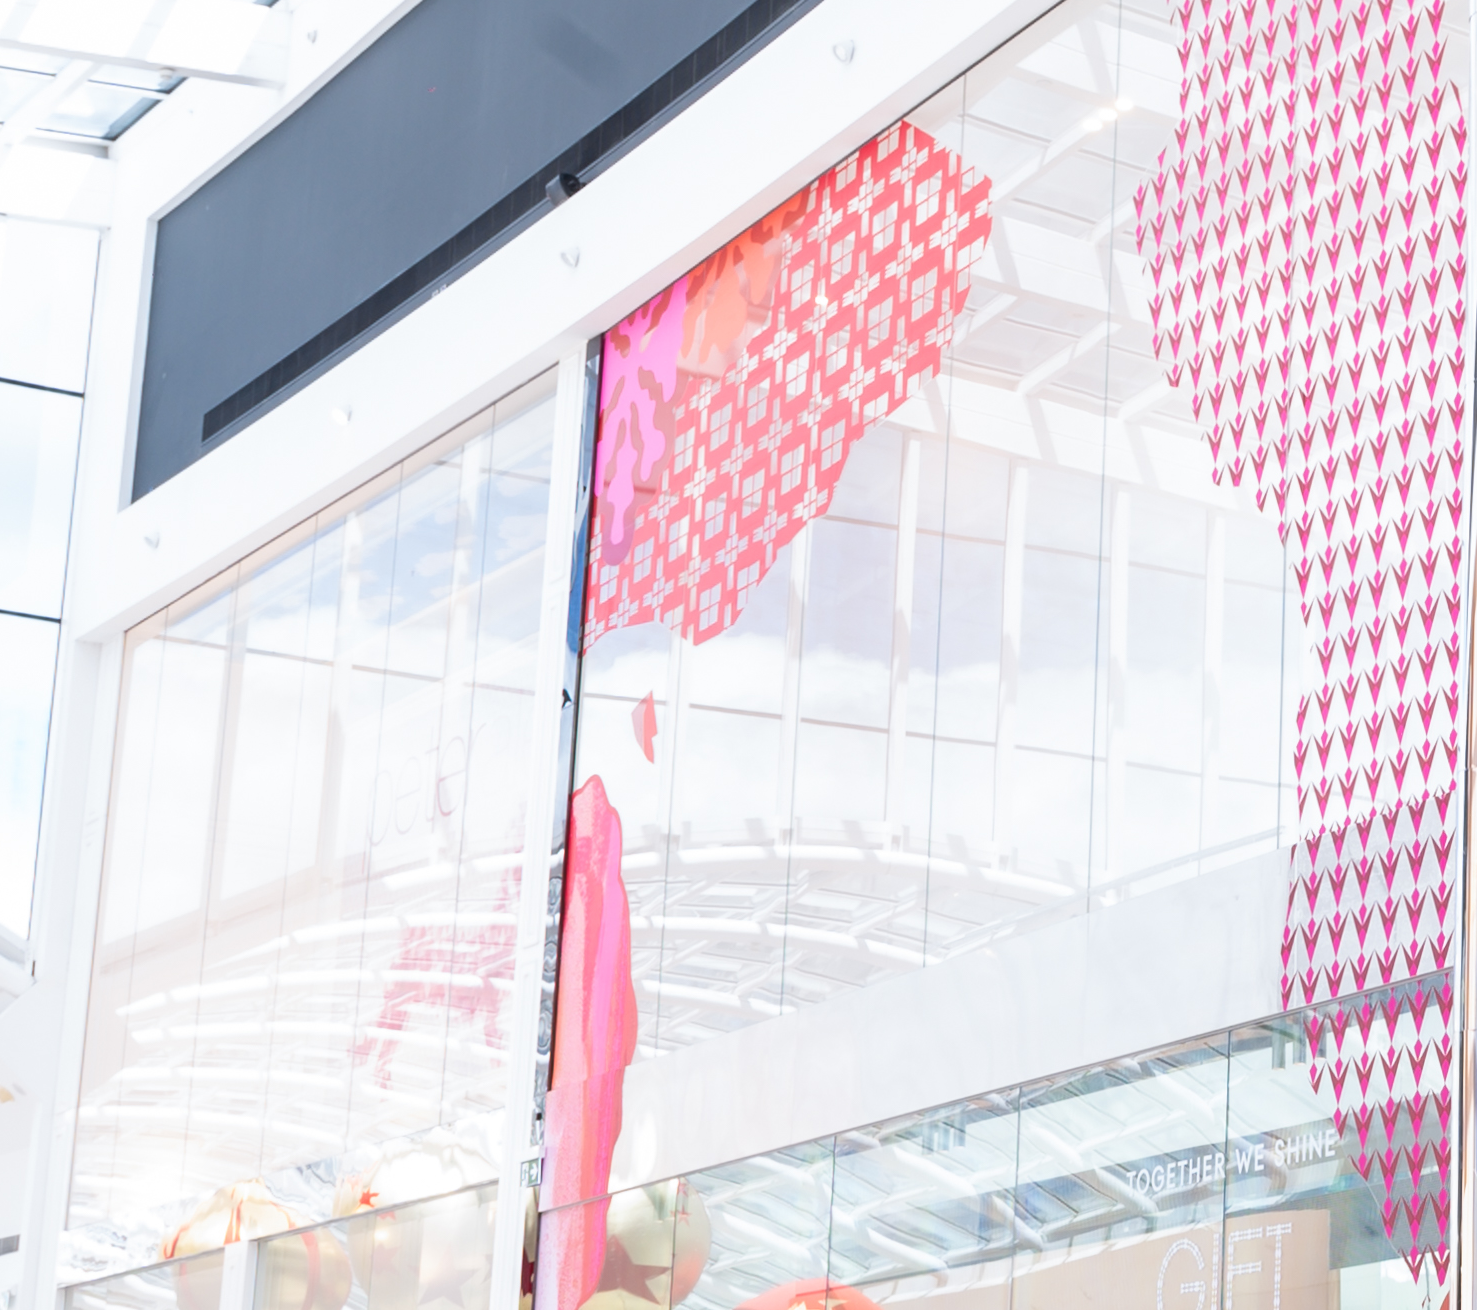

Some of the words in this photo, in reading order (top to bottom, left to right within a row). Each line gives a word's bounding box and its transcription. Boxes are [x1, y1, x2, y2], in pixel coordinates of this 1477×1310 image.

[1126, 1152, 1226, 1194] TOGETHER
[1235, 1143, 1265, 1174] WE
[1274, 1128, 1337, 1167] SHINE
